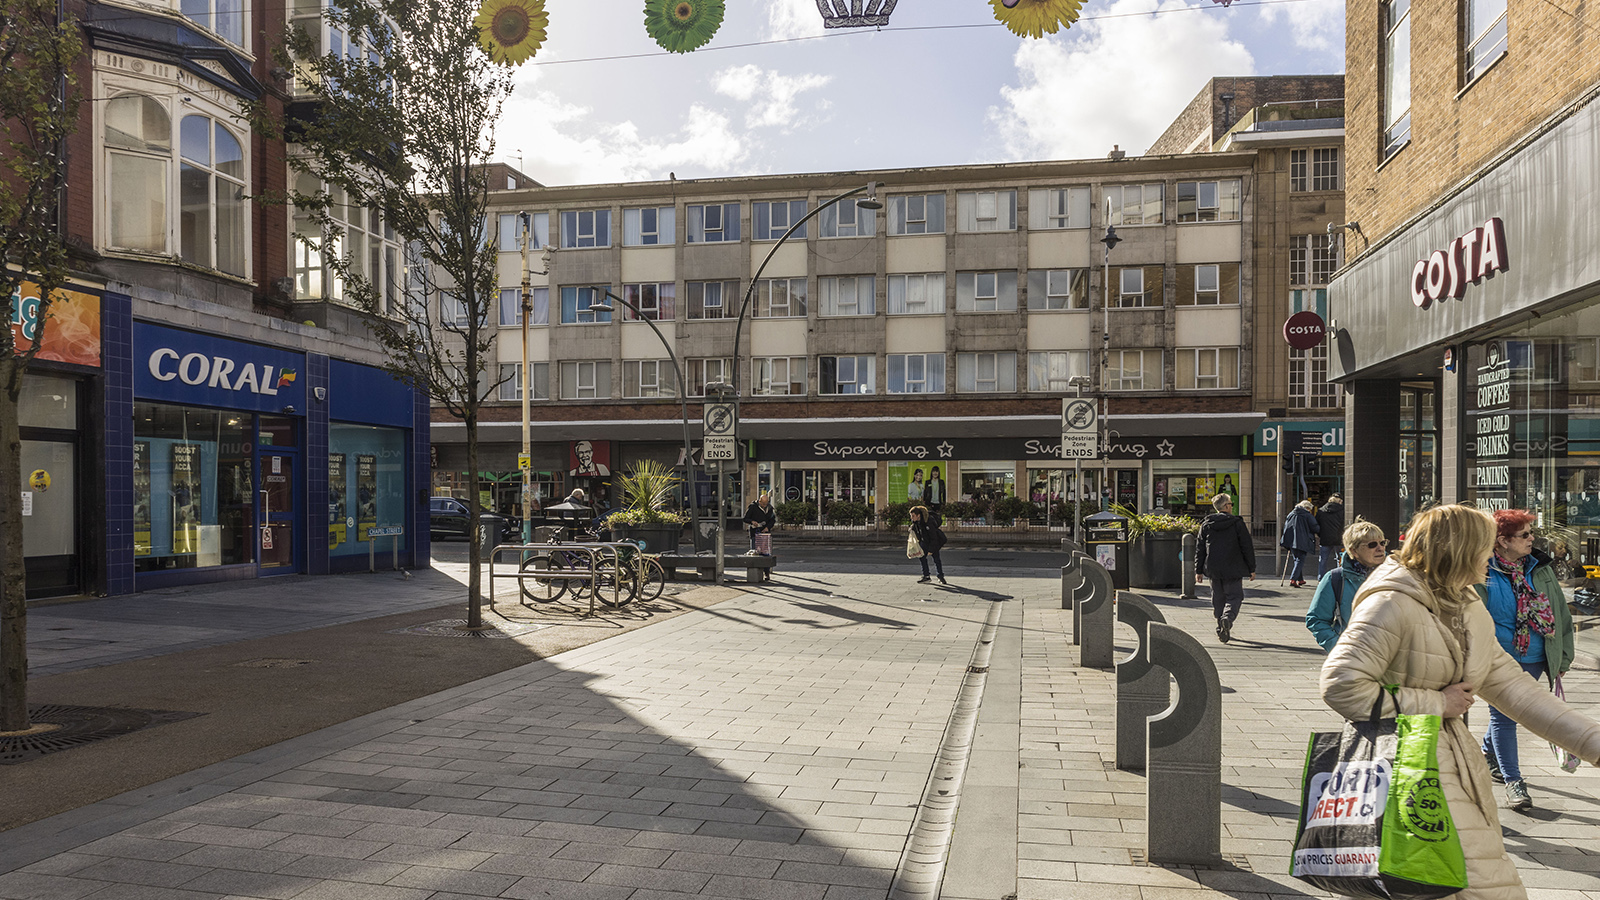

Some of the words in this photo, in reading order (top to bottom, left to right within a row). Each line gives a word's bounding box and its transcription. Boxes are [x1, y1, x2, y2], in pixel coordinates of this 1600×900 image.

[1411, 217, 1507, 309] COSTA
[1289, 325, 1321, 334] COSTA
[148, 347, 278, 396] CORAL
[1477, 368, 1510, 385] HANDCRAFTED
[1477, 382, 1510, 408] COFFEE
[1477, 417, 1492, 434] ICED
[1493, 414, 1510, 433] COLD
[174, 446, 196, 455] BOOST
[813, 441, 930, 459] Superdrug
[1024, 439, 1149, 458] Supdrug
[1066, 449, 1093, 457] ENDS
[1477, 434, 1510, 456] DRINKS
[174, 454, 192, 463] YOUR
[707, 450, 732, 458] ENDS
[174, 463, 192, 471] ACCA
[1476, 466, 1509, 485] PANINIS
[1307, 854, 1333, 865] PRICES
